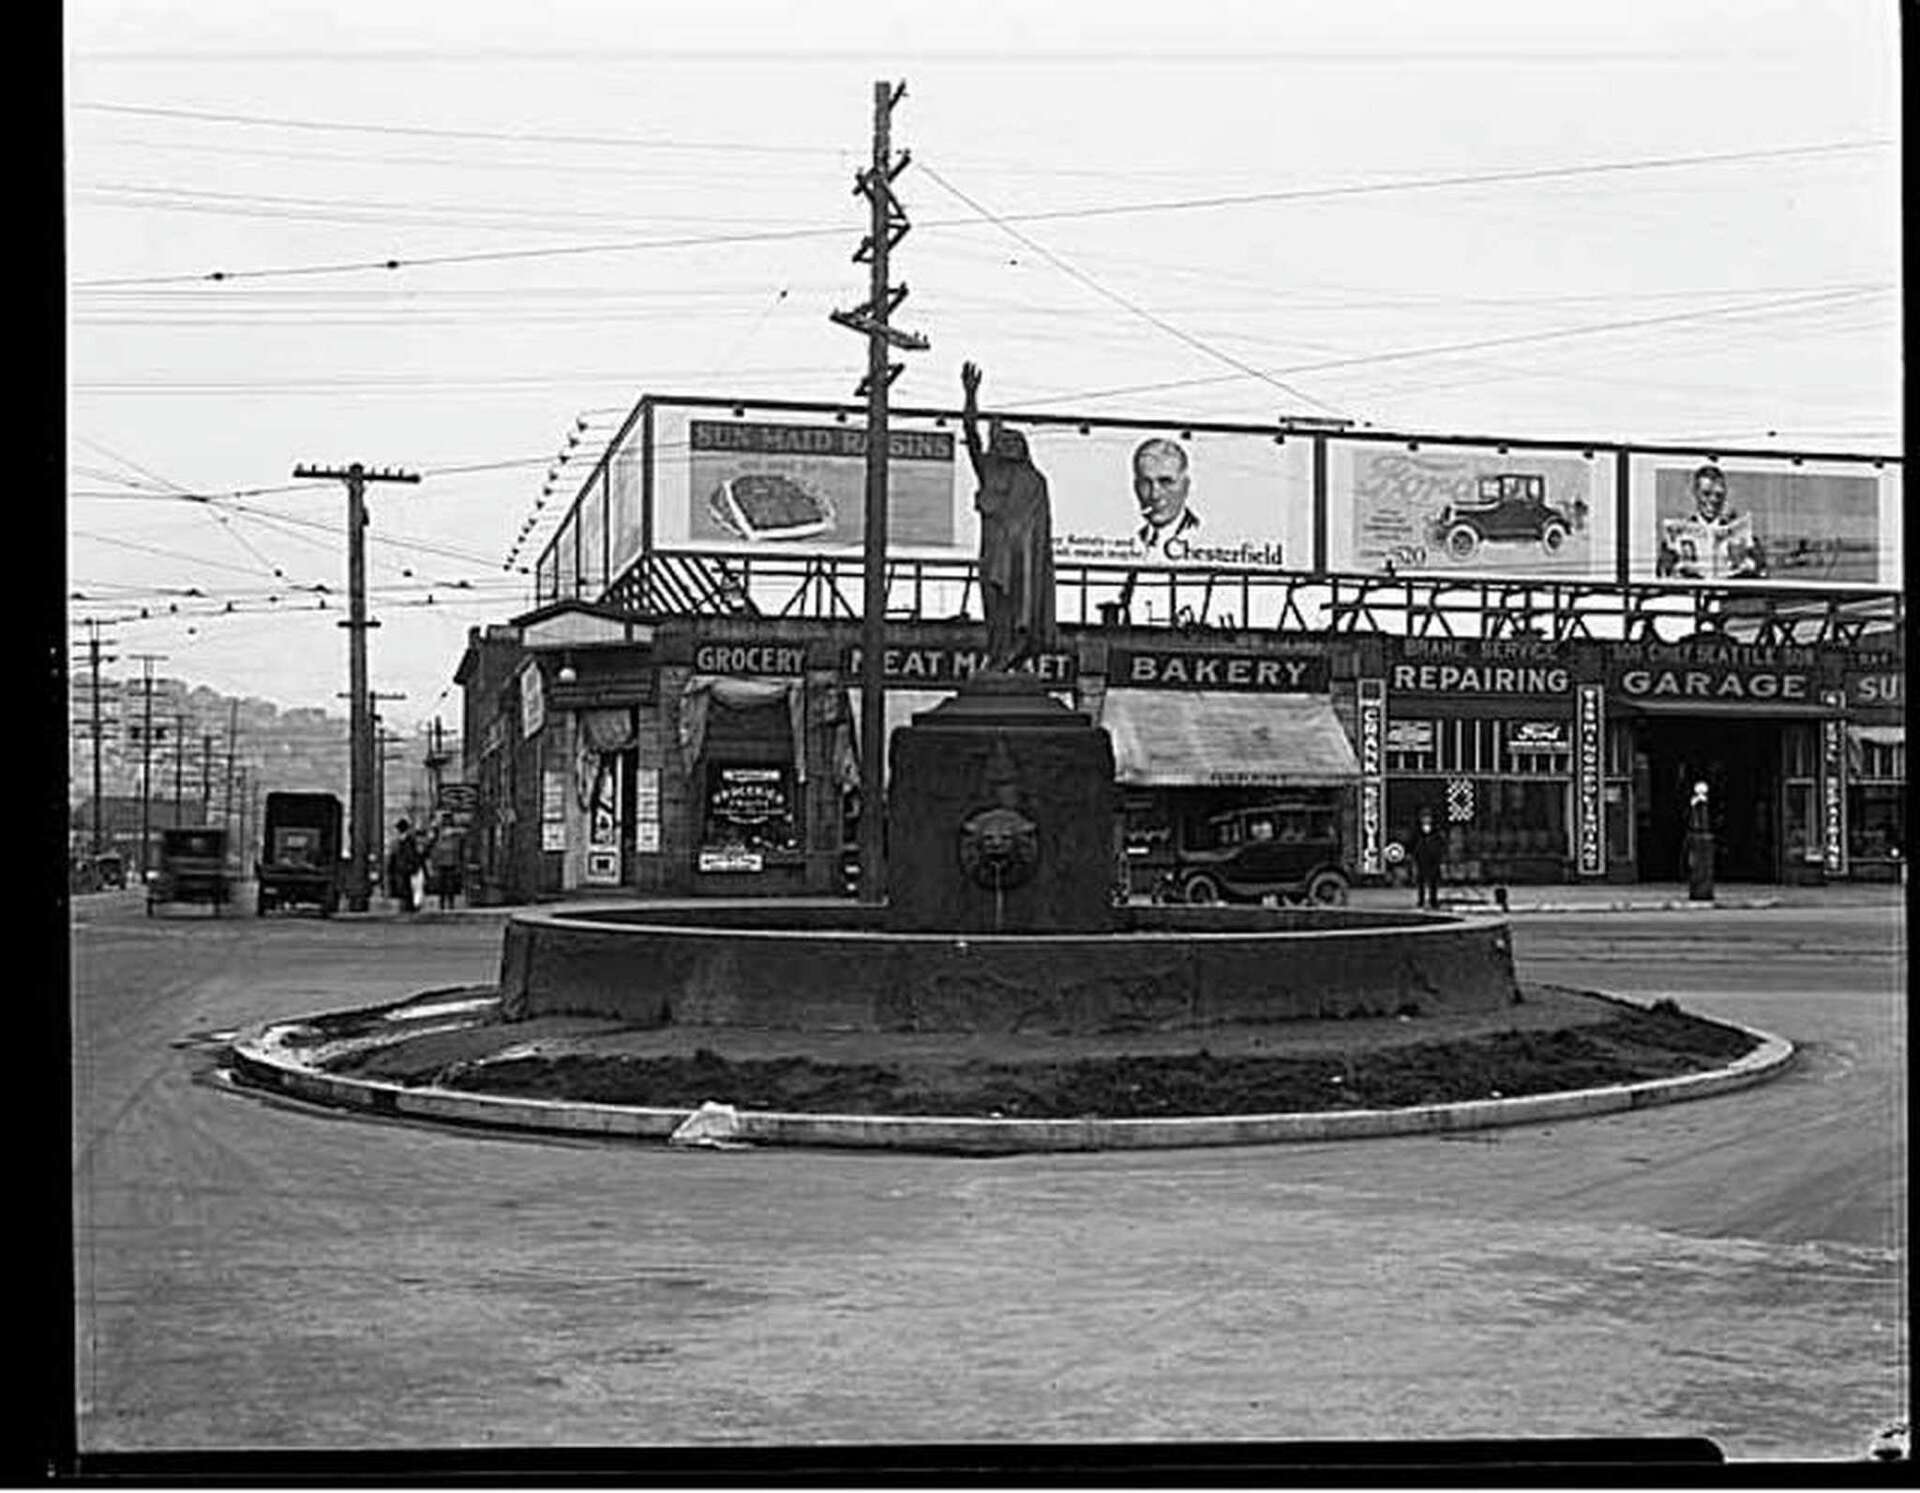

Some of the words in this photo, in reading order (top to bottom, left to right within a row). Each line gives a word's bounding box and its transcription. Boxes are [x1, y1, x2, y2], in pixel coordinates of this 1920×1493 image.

[843, 431, 952, 458] RSINS
[1163, 537, 1283, 566] Chesterfield
[698, 647, 805, 673] GROCERY
[1131, 656, 1308, 685] BAKERY
[1394, 665, 1569, 692] REPAIRING
[1622, 670, 1808, 698] GARAGE
[1858, 673, 1898, 702] SU
